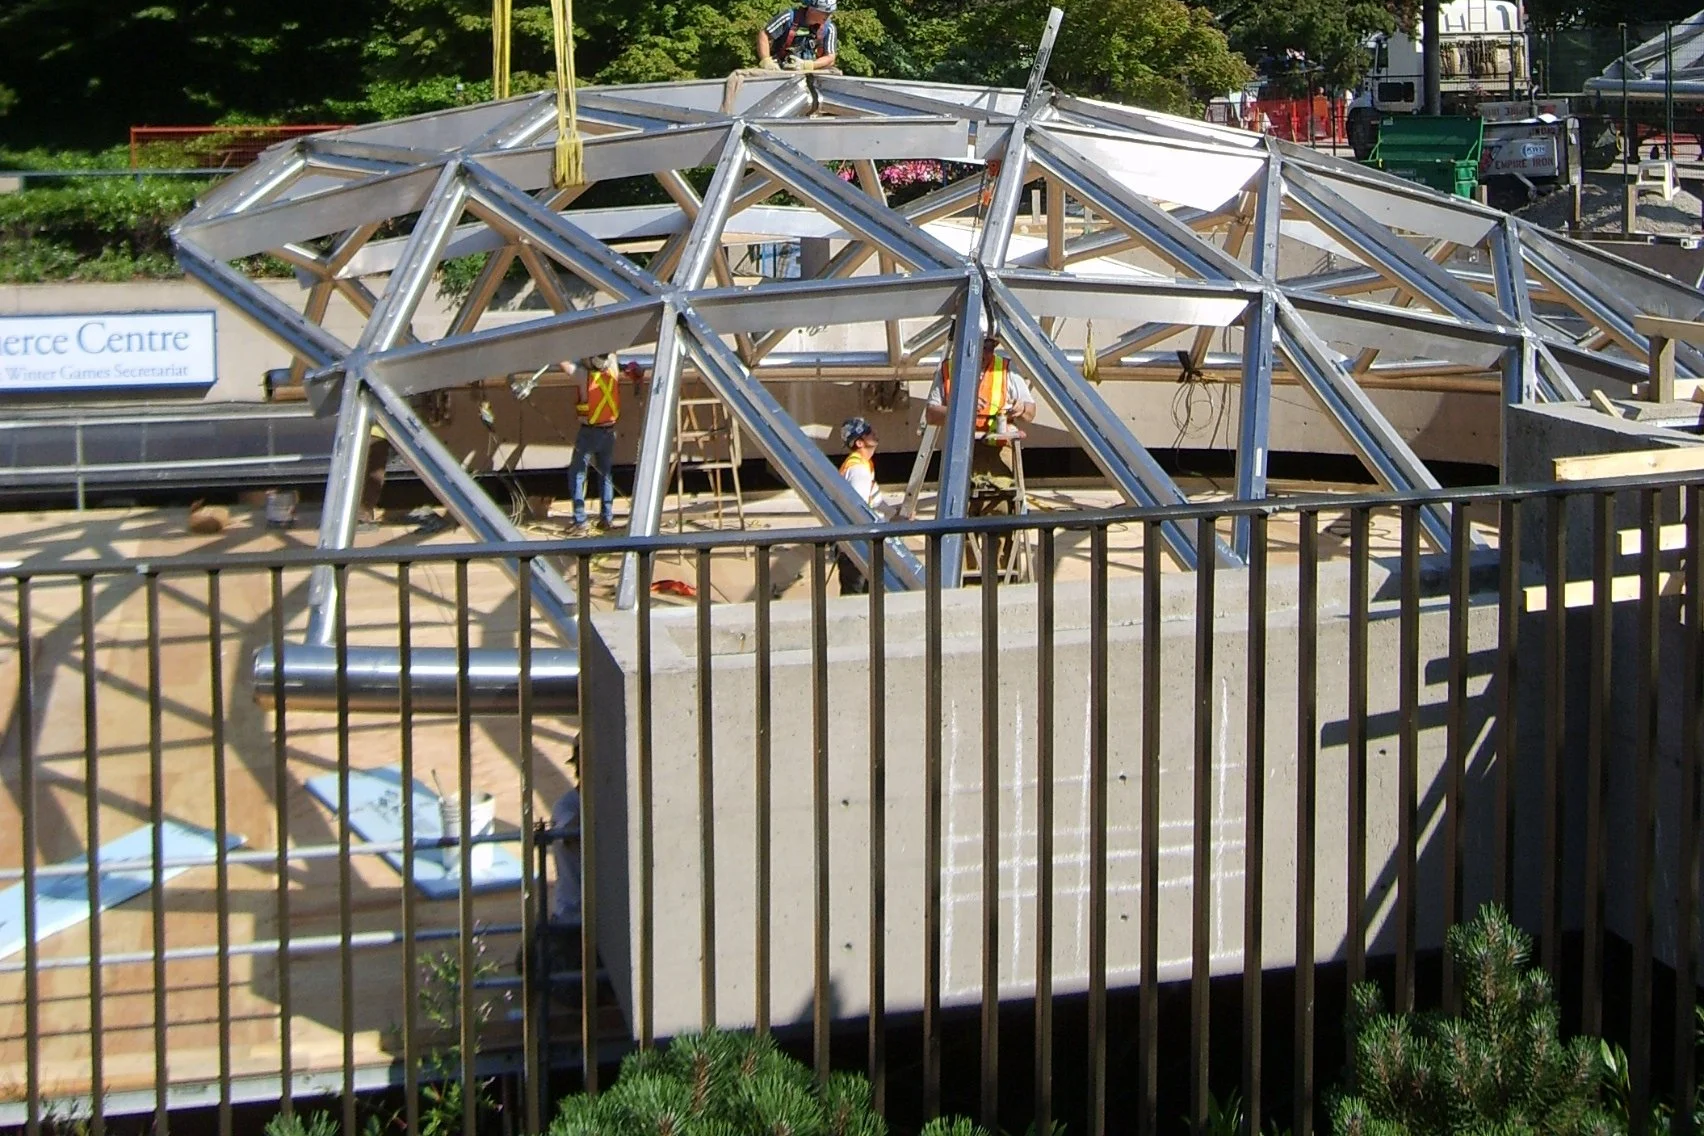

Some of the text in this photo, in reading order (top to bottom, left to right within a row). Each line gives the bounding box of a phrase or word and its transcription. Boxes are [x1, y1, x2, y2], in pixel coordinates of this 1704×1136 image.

[1495, 157, 1553, 169] EMPIRE IRON
[0, 321, 190, 356] erce Centre
[5, 364, 188, 381] Winter Games Secretariat
